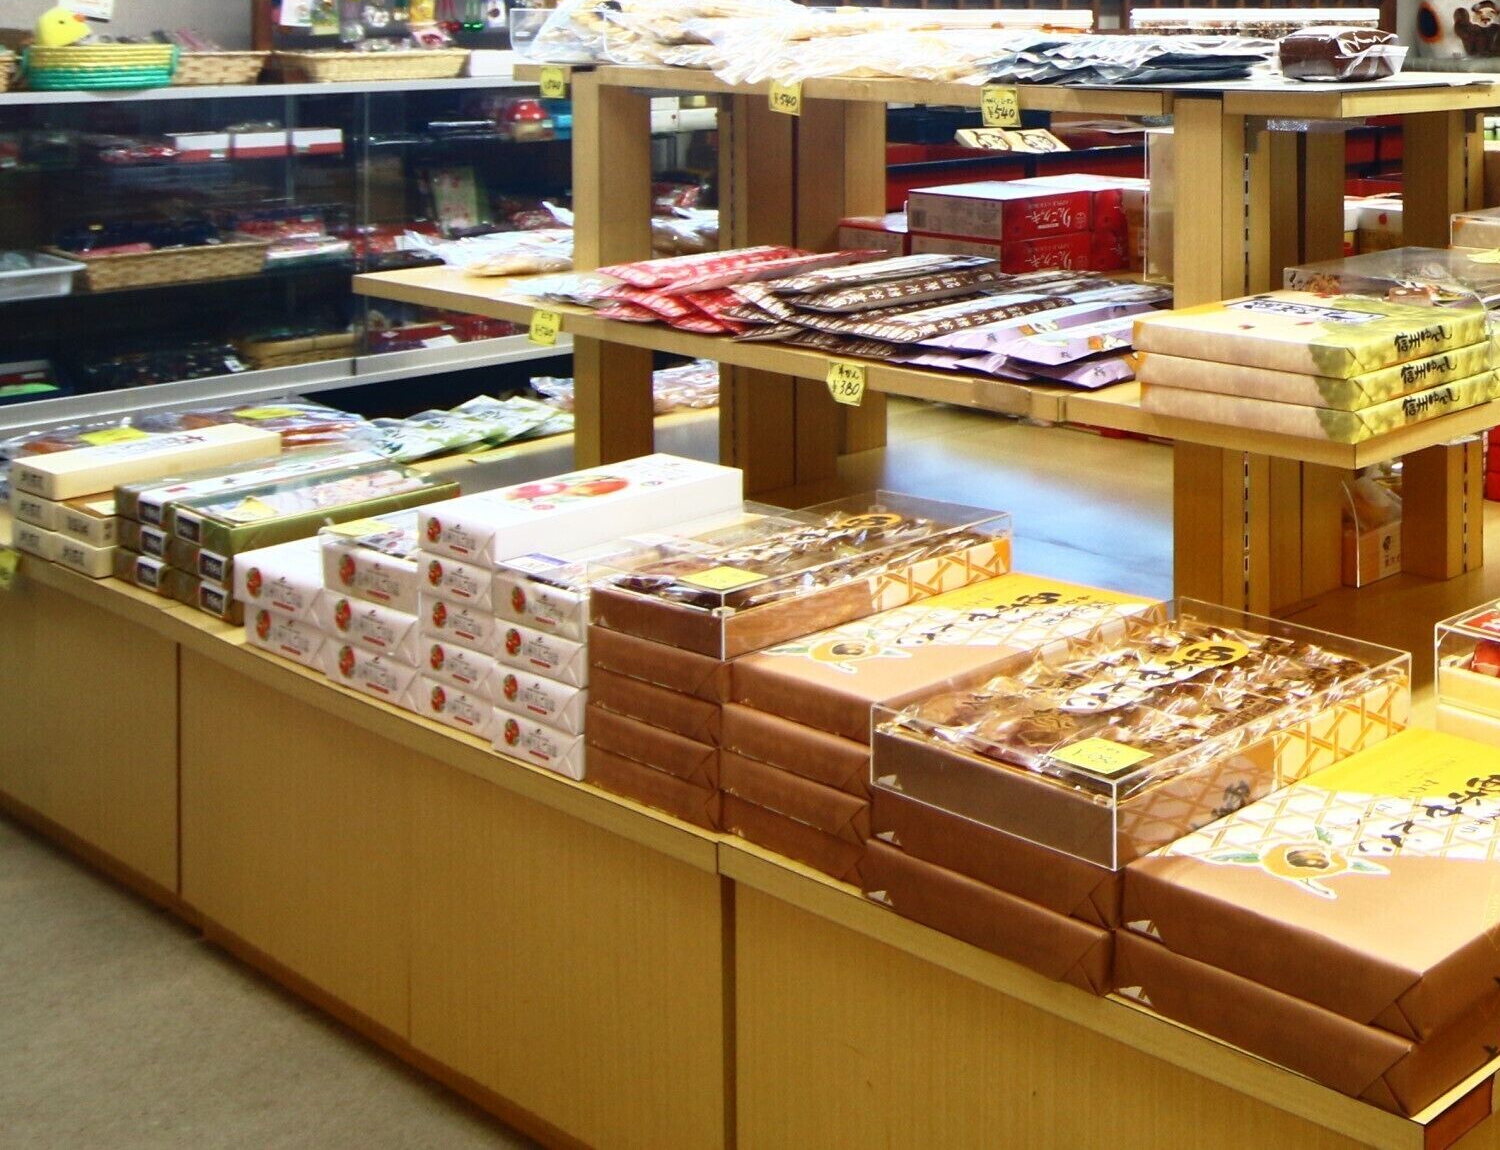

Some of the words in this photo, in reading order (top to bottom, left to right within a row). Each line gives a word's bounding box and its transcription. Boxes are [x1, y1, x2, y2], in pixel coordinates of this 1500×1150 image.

[987, 104, 1015, 120] ¥540
[1394, 325, 1452, 352] 信州ゆべし
[1400, 355, 1457, 385] 信州ゆべし
[833, 380, 860, 396] ¥380
[1402, 387, 1460, 417] 信州ゆべし
